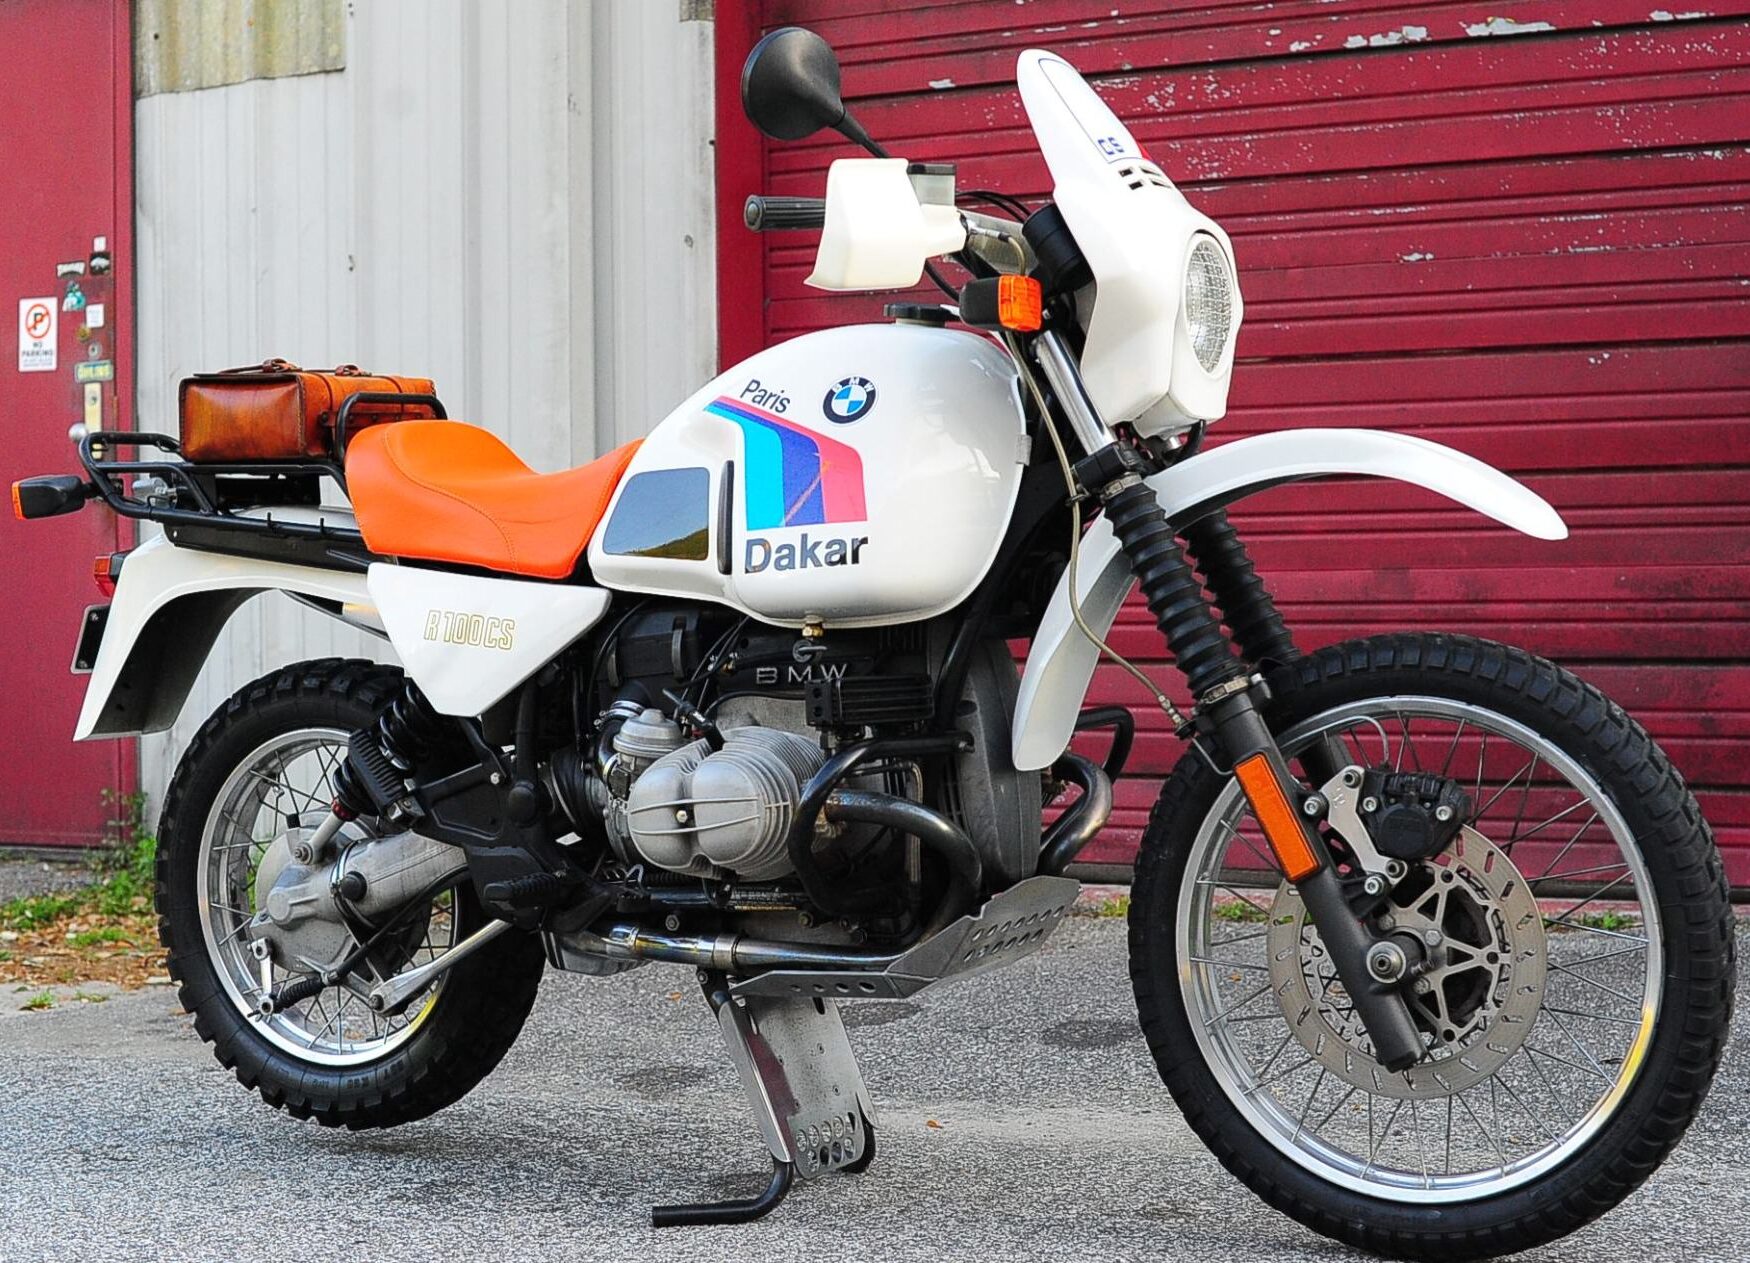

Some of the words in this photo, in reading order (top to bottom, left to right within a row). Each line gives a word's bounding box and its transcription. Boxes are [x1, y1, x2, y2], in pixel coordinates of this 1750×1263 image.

[740, 379, 790, 413] Paris
[745, 533, 868, 574] Dakar
[756, 664, 847, 684] BMW
